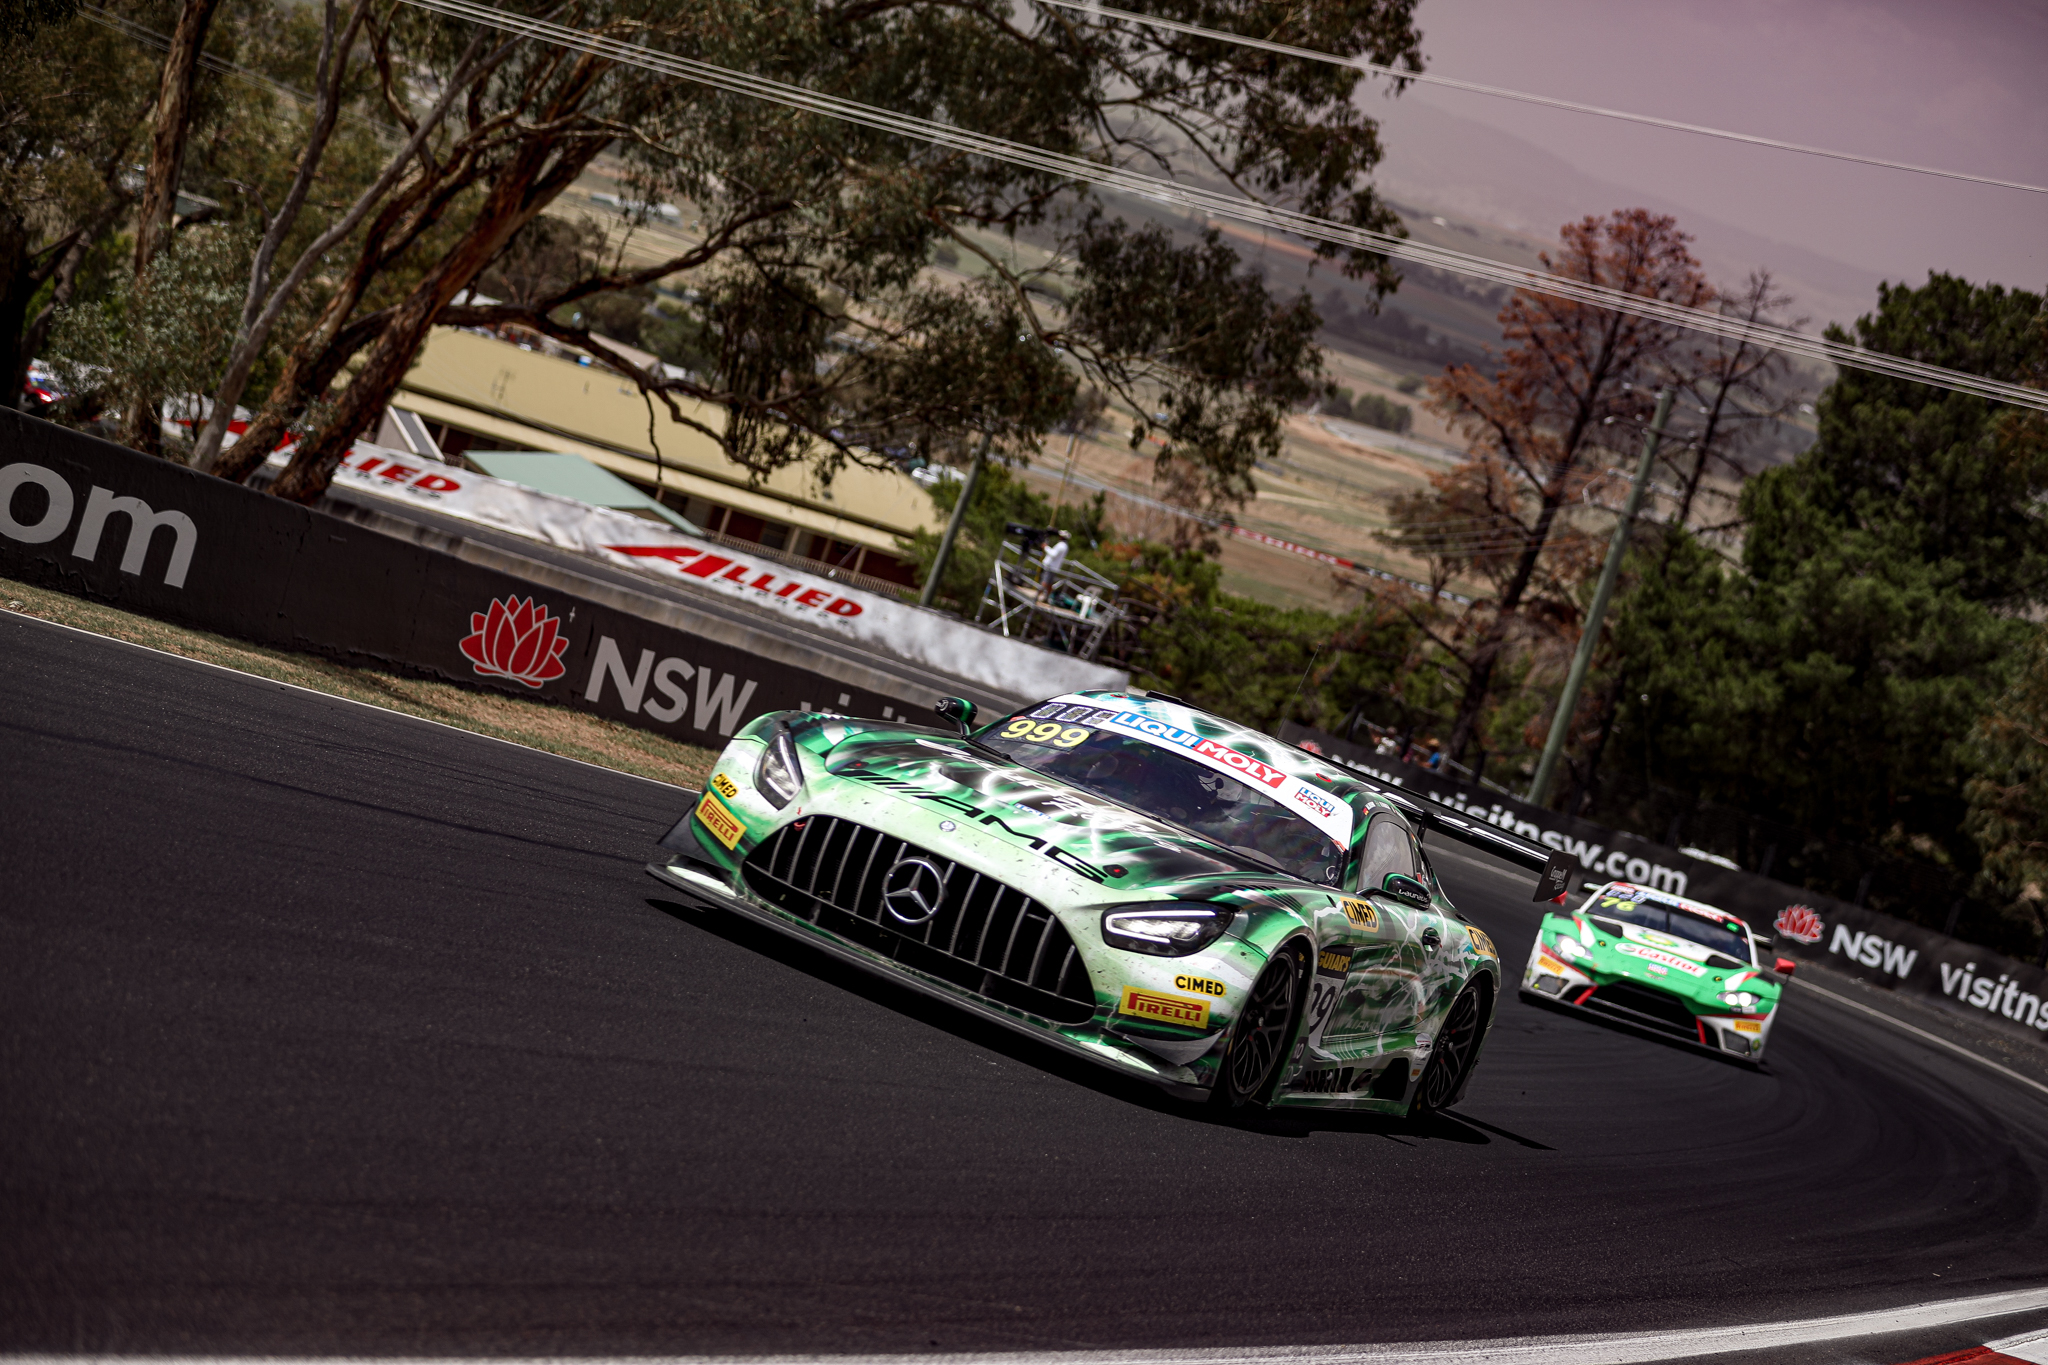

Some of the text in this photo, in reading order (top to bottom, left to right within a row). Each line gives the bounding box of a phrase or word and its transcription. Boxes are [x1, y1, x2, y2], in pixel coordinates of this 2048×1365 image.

[599, 545, 864, 617] ALLIED
[584, 635, 758, 737] NSW
[1000, 719, 1090, 749] 999
[1115, 712, 1201, 748] LIQUI
[1202, 740, 1286, 784] MOLY
[1294, 792, 1332, 818] MOLY
[1298, 787, 1336, 813] LIQUI
[700, 798, 739, 841] PIRELLI
[912, 796, 1108, 884] AMG
[1343, 901, 1378, 928] CIMED
[1600, 897, 1637, 912] 76
[1318, 950, 1351, 973] GUIAR'S
[1637, 947, 1700, 974] Castrol
[1829, 924, 1919, 979] NSW
[1175, 975, 1224, 996] CIMED
[1127, 992, 1203, 1022] PIRELLI
